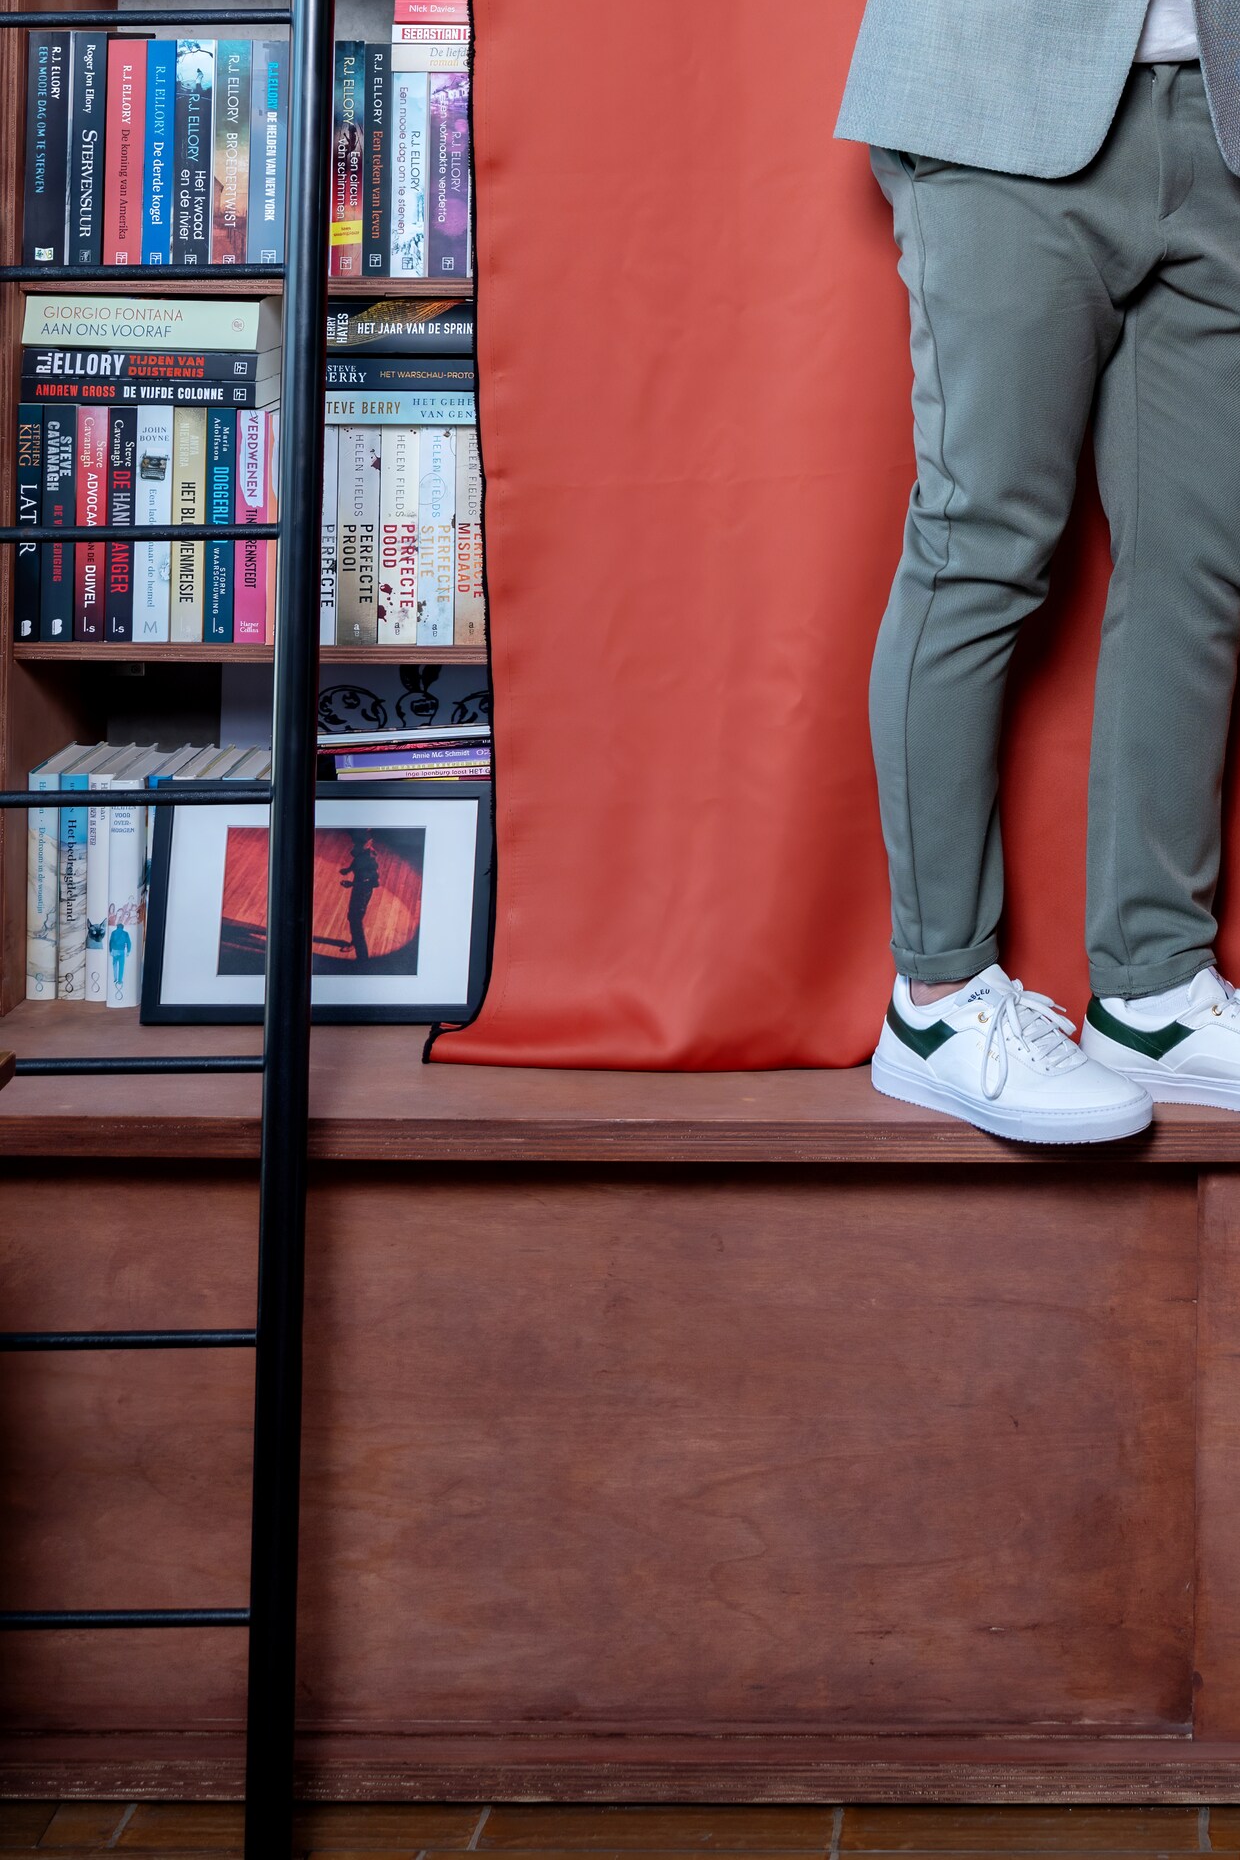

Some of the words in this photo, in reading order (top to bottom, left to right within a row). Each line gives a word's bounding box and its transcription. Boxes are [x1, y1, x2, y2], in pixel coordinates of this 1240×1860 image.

[373, 78, 383, 124] ELLORY
[79, 129, 97, 237] STERVENSUUR
[193, 170, 206, 192] Het
[224, 132, 238, 227] BROEDERTWIST
[192, 196, 205, 240] kwaad
[43, 306, 111, 319] GIORGIO
[115, 308, 183, 321] FONTANA
[336, 313, 349, 344] HAYES
[51, 353, 125, 376] ELLORY
[19, 423, 33, 466] KING
[342, 524, 356, 572] PROOI
[359, 524, 374, 604] PERFECTE
[382, 524, 397, 568] DOOD
[399, 524, 415, 608] PERFECTE
[66, 819, 77, 839] Het
[64, 841, 77, 896] bedreigde
[66, 899, 76, 922] land
